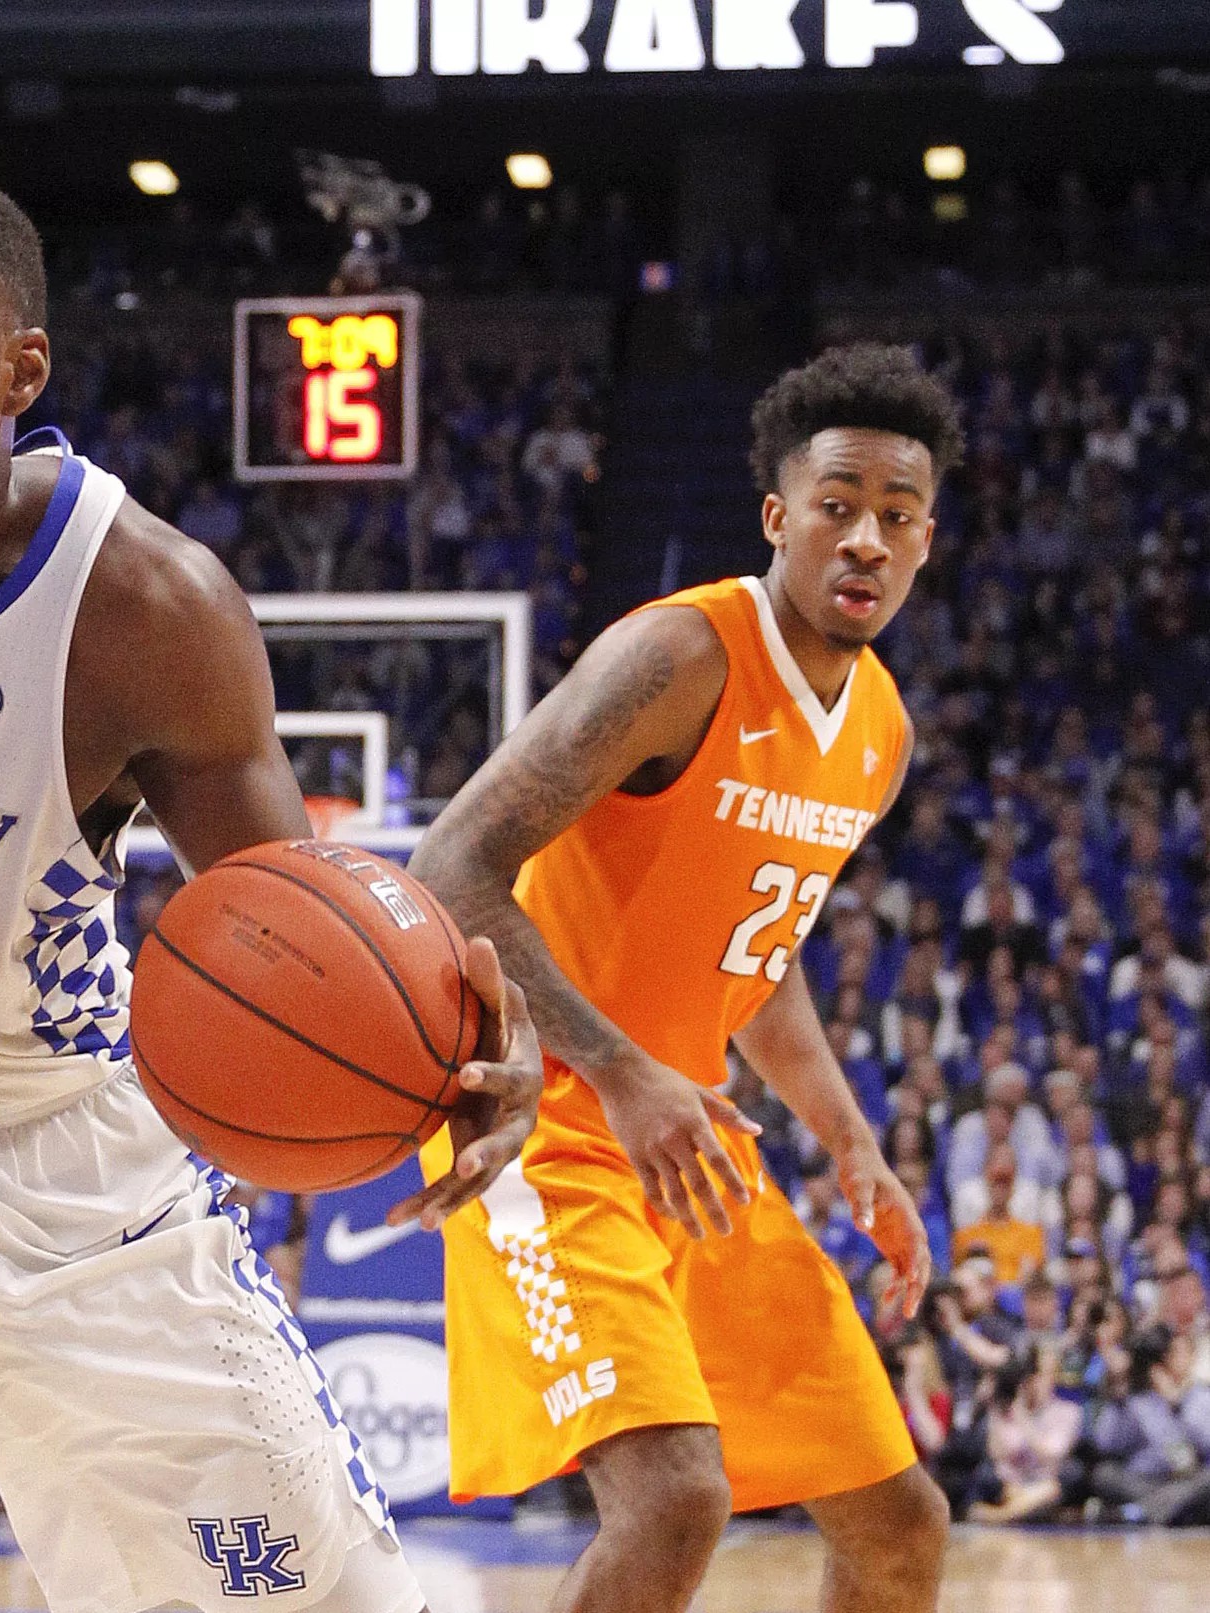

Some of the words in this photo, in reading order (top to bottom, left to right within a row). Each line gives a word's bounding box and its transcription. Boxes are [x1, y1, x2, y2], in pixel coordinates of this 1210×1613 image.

[304, 367, 383, 462] 15
[719, 861, 831, 983] 23
[542, 1357, 618, 1427] VOLS
[187, 1513, 307, 1597] UK
